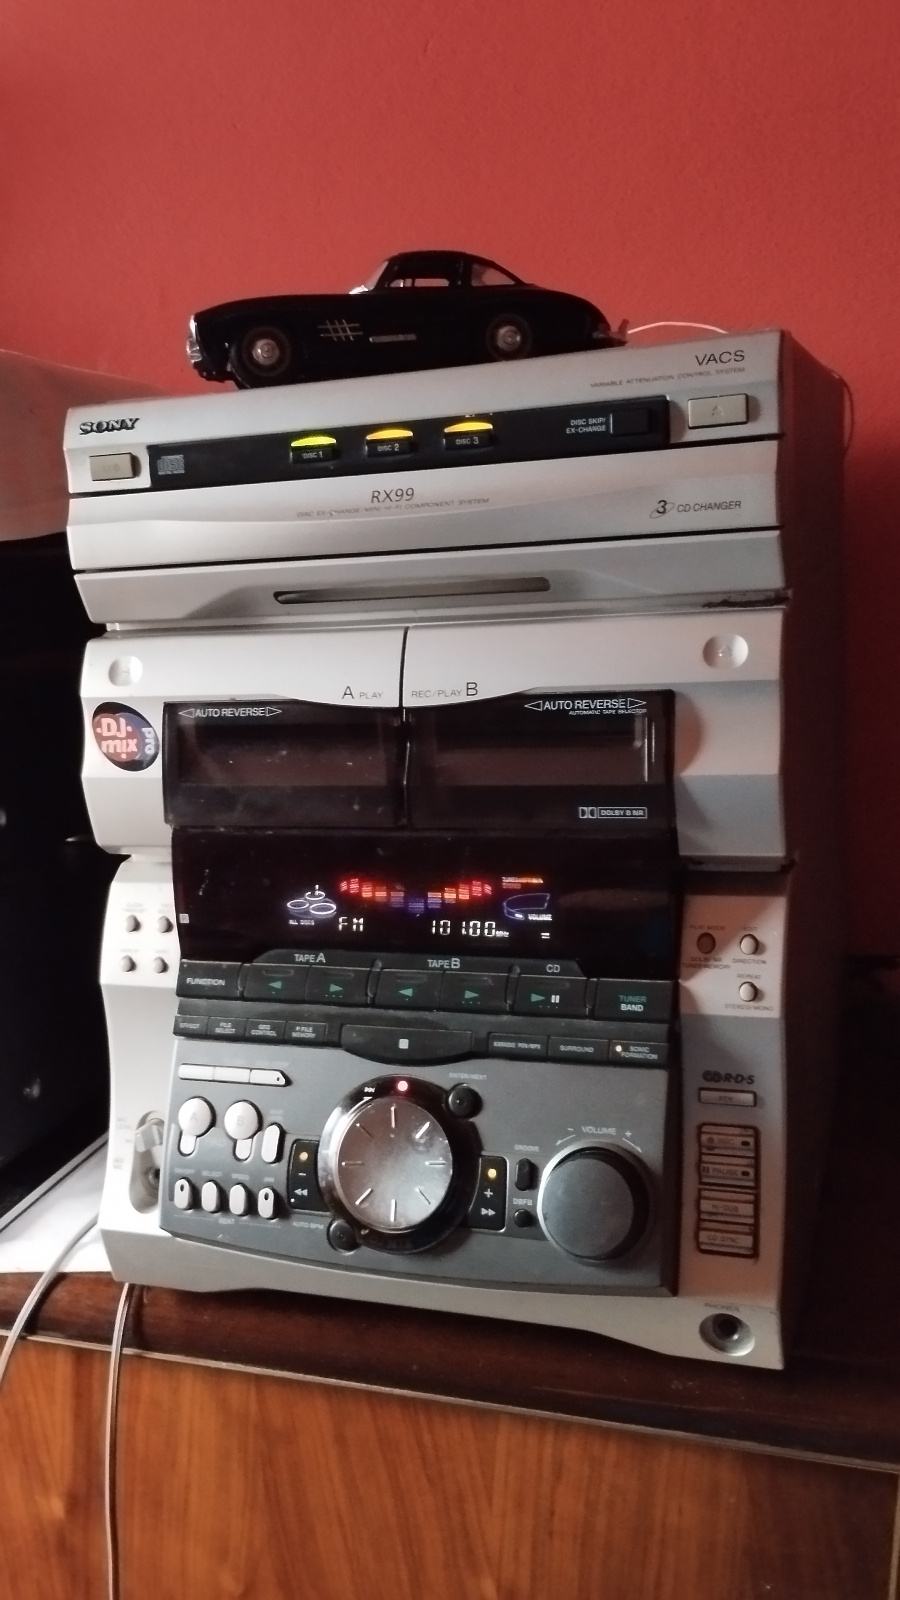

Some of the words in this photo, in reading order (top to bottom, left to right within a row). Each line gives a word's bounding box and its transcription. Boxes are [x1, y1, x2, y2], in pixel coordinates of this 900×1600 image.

[695, 350, 745, 366] VACS
[79, 417, 140, 435] SONY
[570, 418, 587, 426] DISC
[566, 424, 607, 434] EX-CHANGE
[473, 436, 479, 445] 3
[377, 444, 392, 452] DISC
[303, 451, 318, 459] DISC
[370, 487, 415, 504] RX99
[656, 499, 668, 515] 3
[677, 503, 691, 512] CD
[693, 500, 742, 512] CHANGER
[341, 685, 354, 699] A
[359, 691, 384, 699] PLAY
[466, 681, 478, 696] B
[543, 700, 573, 710] AUTO
[574, 698, 626, 709] REVERSE
[194, 708, 220, 718] AUTO
[221, 707, 265, 717] REVERSE
[100, 738, 138, 758] mix
[338, 916, 364, 932] FM
[545, 964, 561, 973] CD
[186, 977, 226, 986] FUNCTION
[618, 994, 647, 1003] TUNER
[620, 1003, 644, 1012] BAND
[581, 1125, 617, 1136] VOLUME
